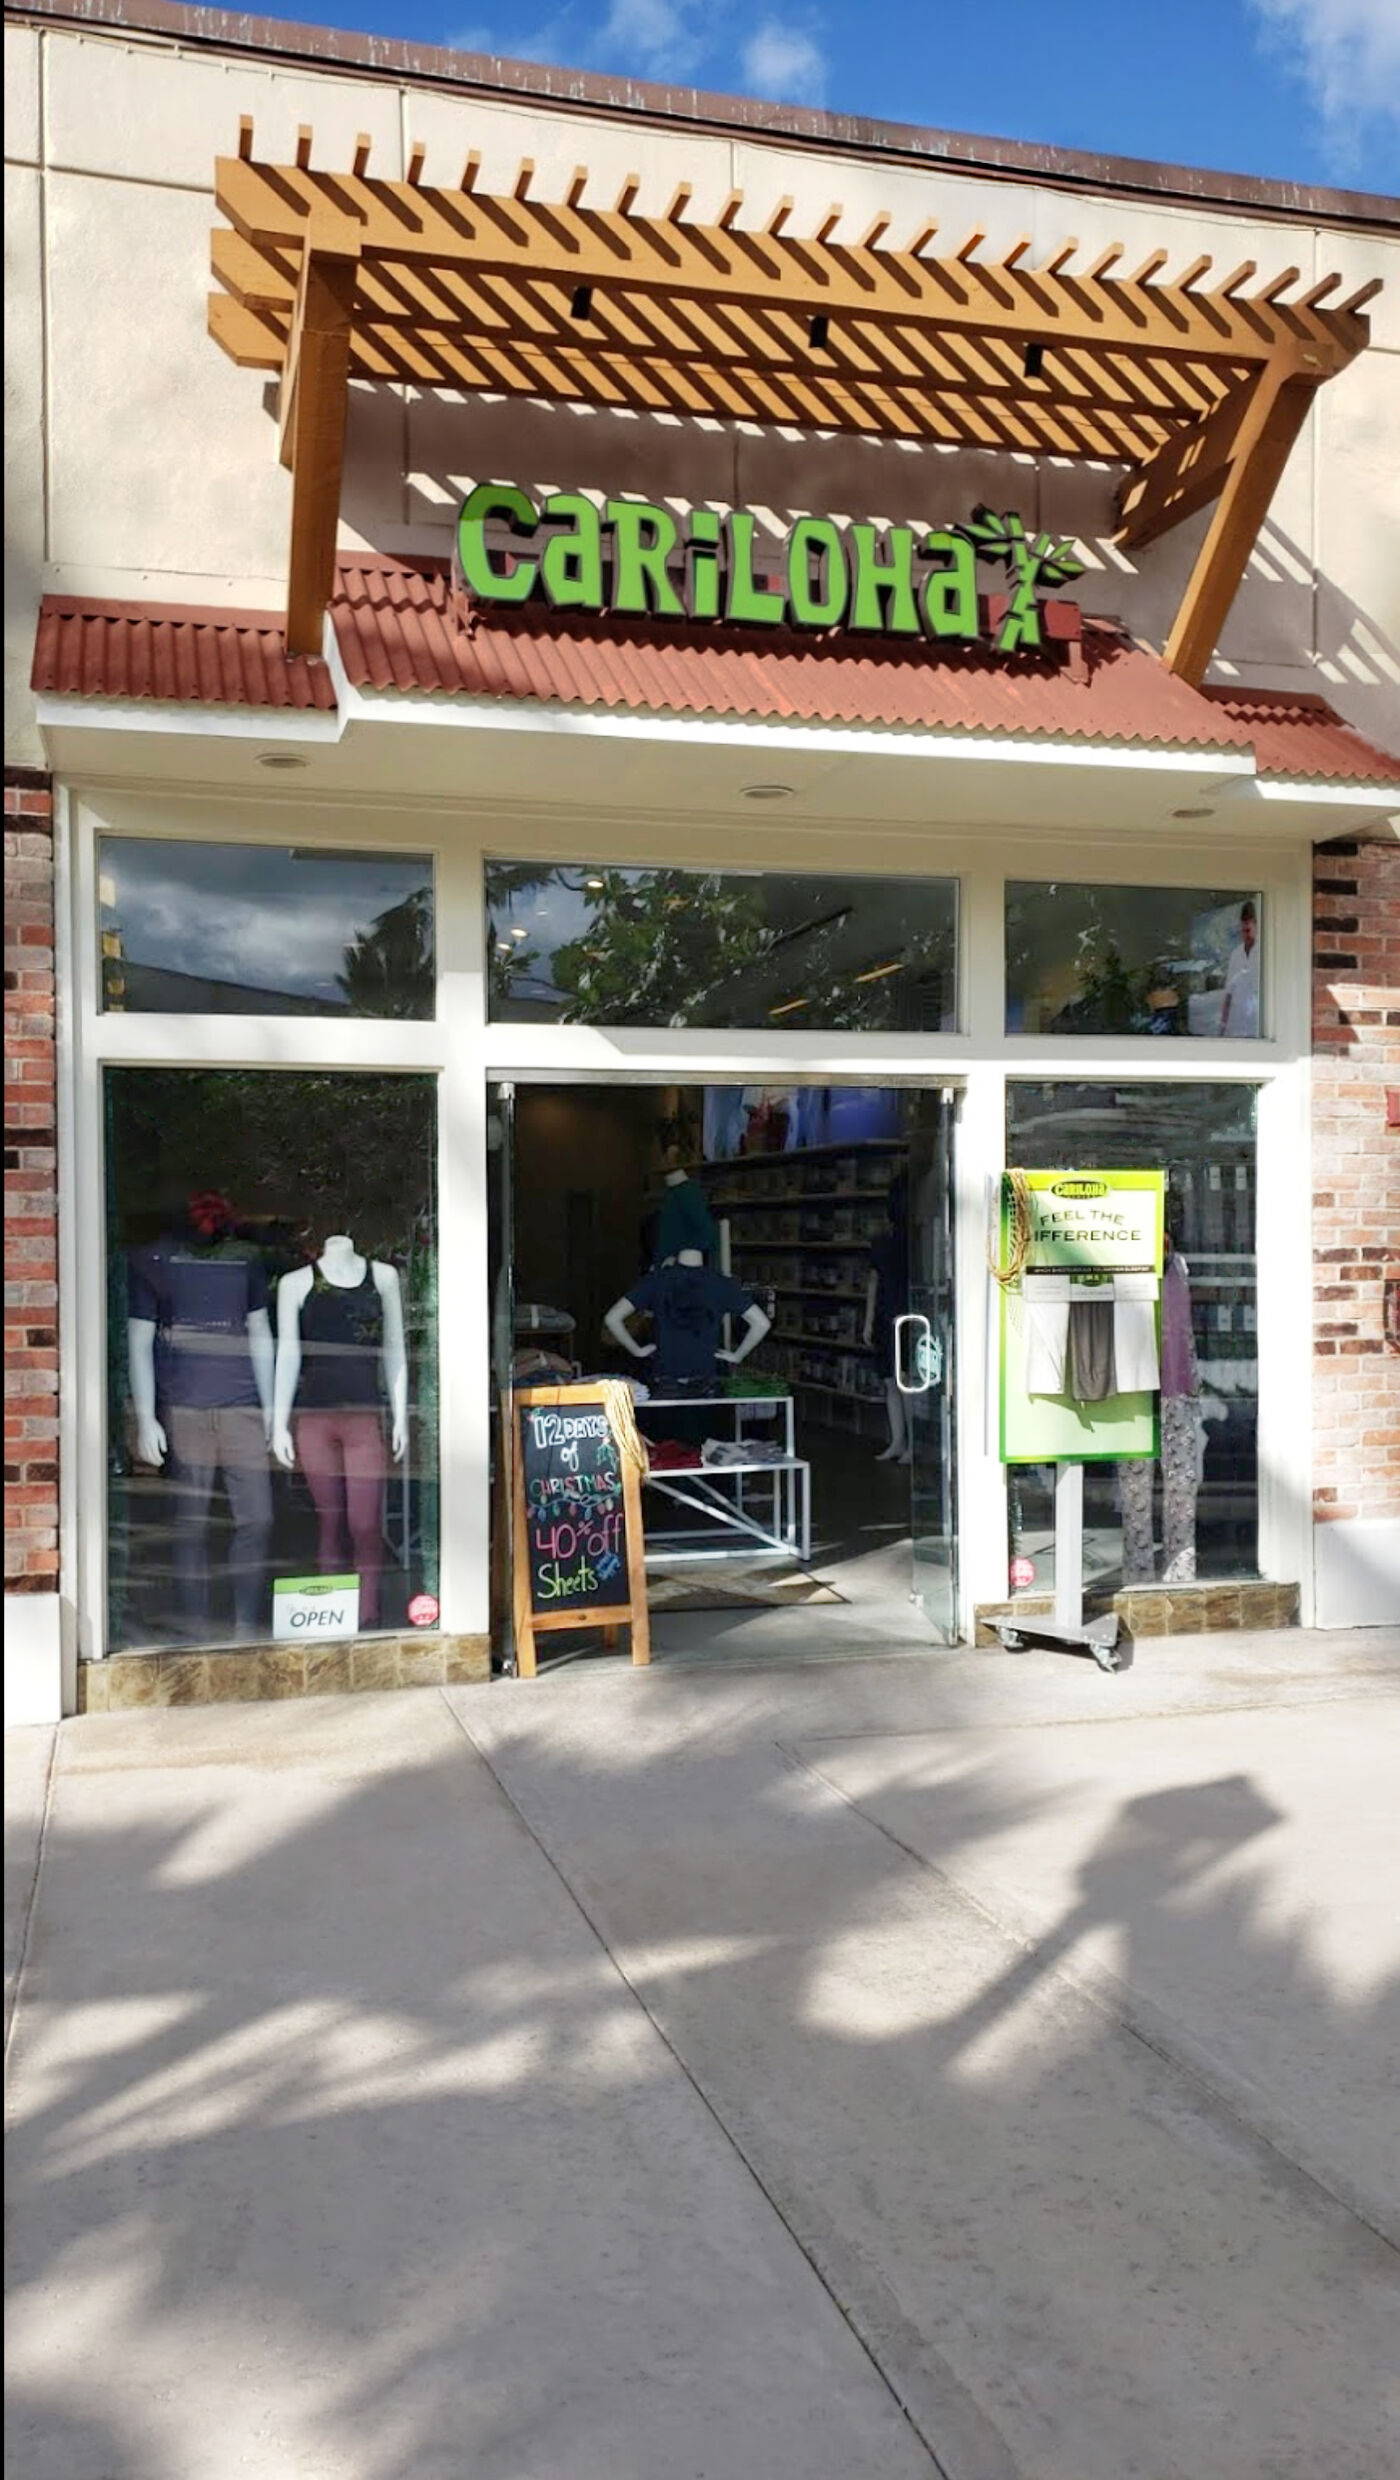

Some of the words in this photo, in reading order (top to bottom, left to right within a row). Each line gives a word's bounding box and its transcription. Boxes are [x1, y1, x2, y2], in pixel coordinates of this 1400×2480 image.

[1040, 1210, 1085, 1226] FEEL
[1090, 1210, 1125, 1226] THE
[1032, 1229, 1142, 1242] IFFERENCE
[534, 1413, 566, 1450] 12
[563, 1415, 608, 1439] DAYS
[561, 1440, 579, 1472] of
[530, 1471, 616, 1497] CHRISTMAS
[536, 1520, 594, 1559] 40%
[588, 1513, 623, 1556] off
[537, 1553, 599, 1598] Sheets
[290, 1609, 344, 1628] OPEN
